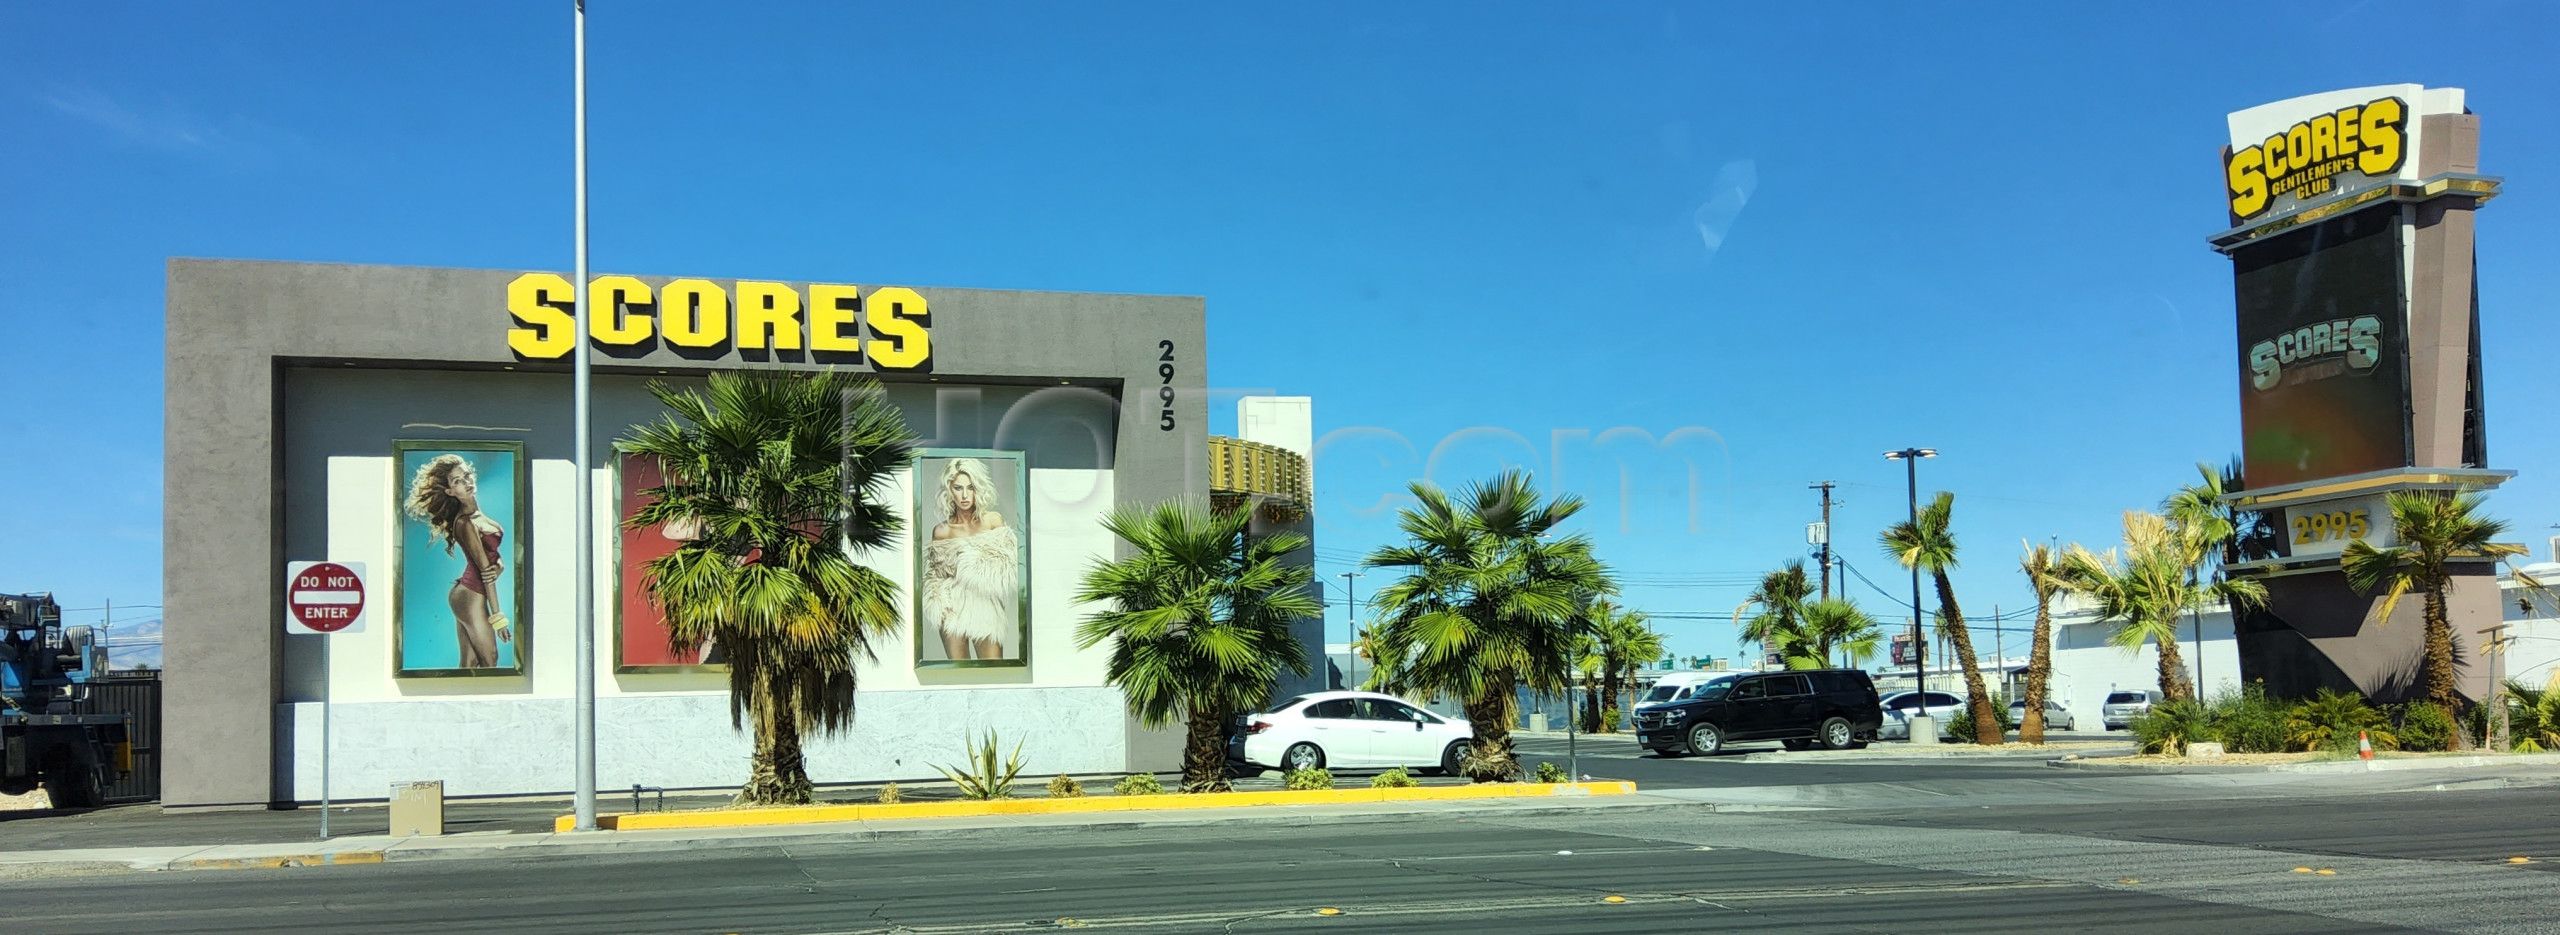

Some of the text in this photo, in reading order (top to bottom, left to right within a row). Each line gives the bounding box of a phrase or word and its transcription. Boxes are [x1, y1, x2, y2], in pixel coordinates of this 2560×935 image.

[2228, 97, 2401, 218] SCORES
[2272, 157, 2355, 195] GENTLEMEN'S
[2296, 178, 2330, 200] CLUB
[508, 272, 931, 368] SCORES
[2249, 315, 2382, 391] SCORES
[1159, 339, 1175, 432] 2995
[2292, 508, 2368, 545] 2995
[301, 576, 354, 588] DO NOT
[305, 607, 348, 619] ENTER
